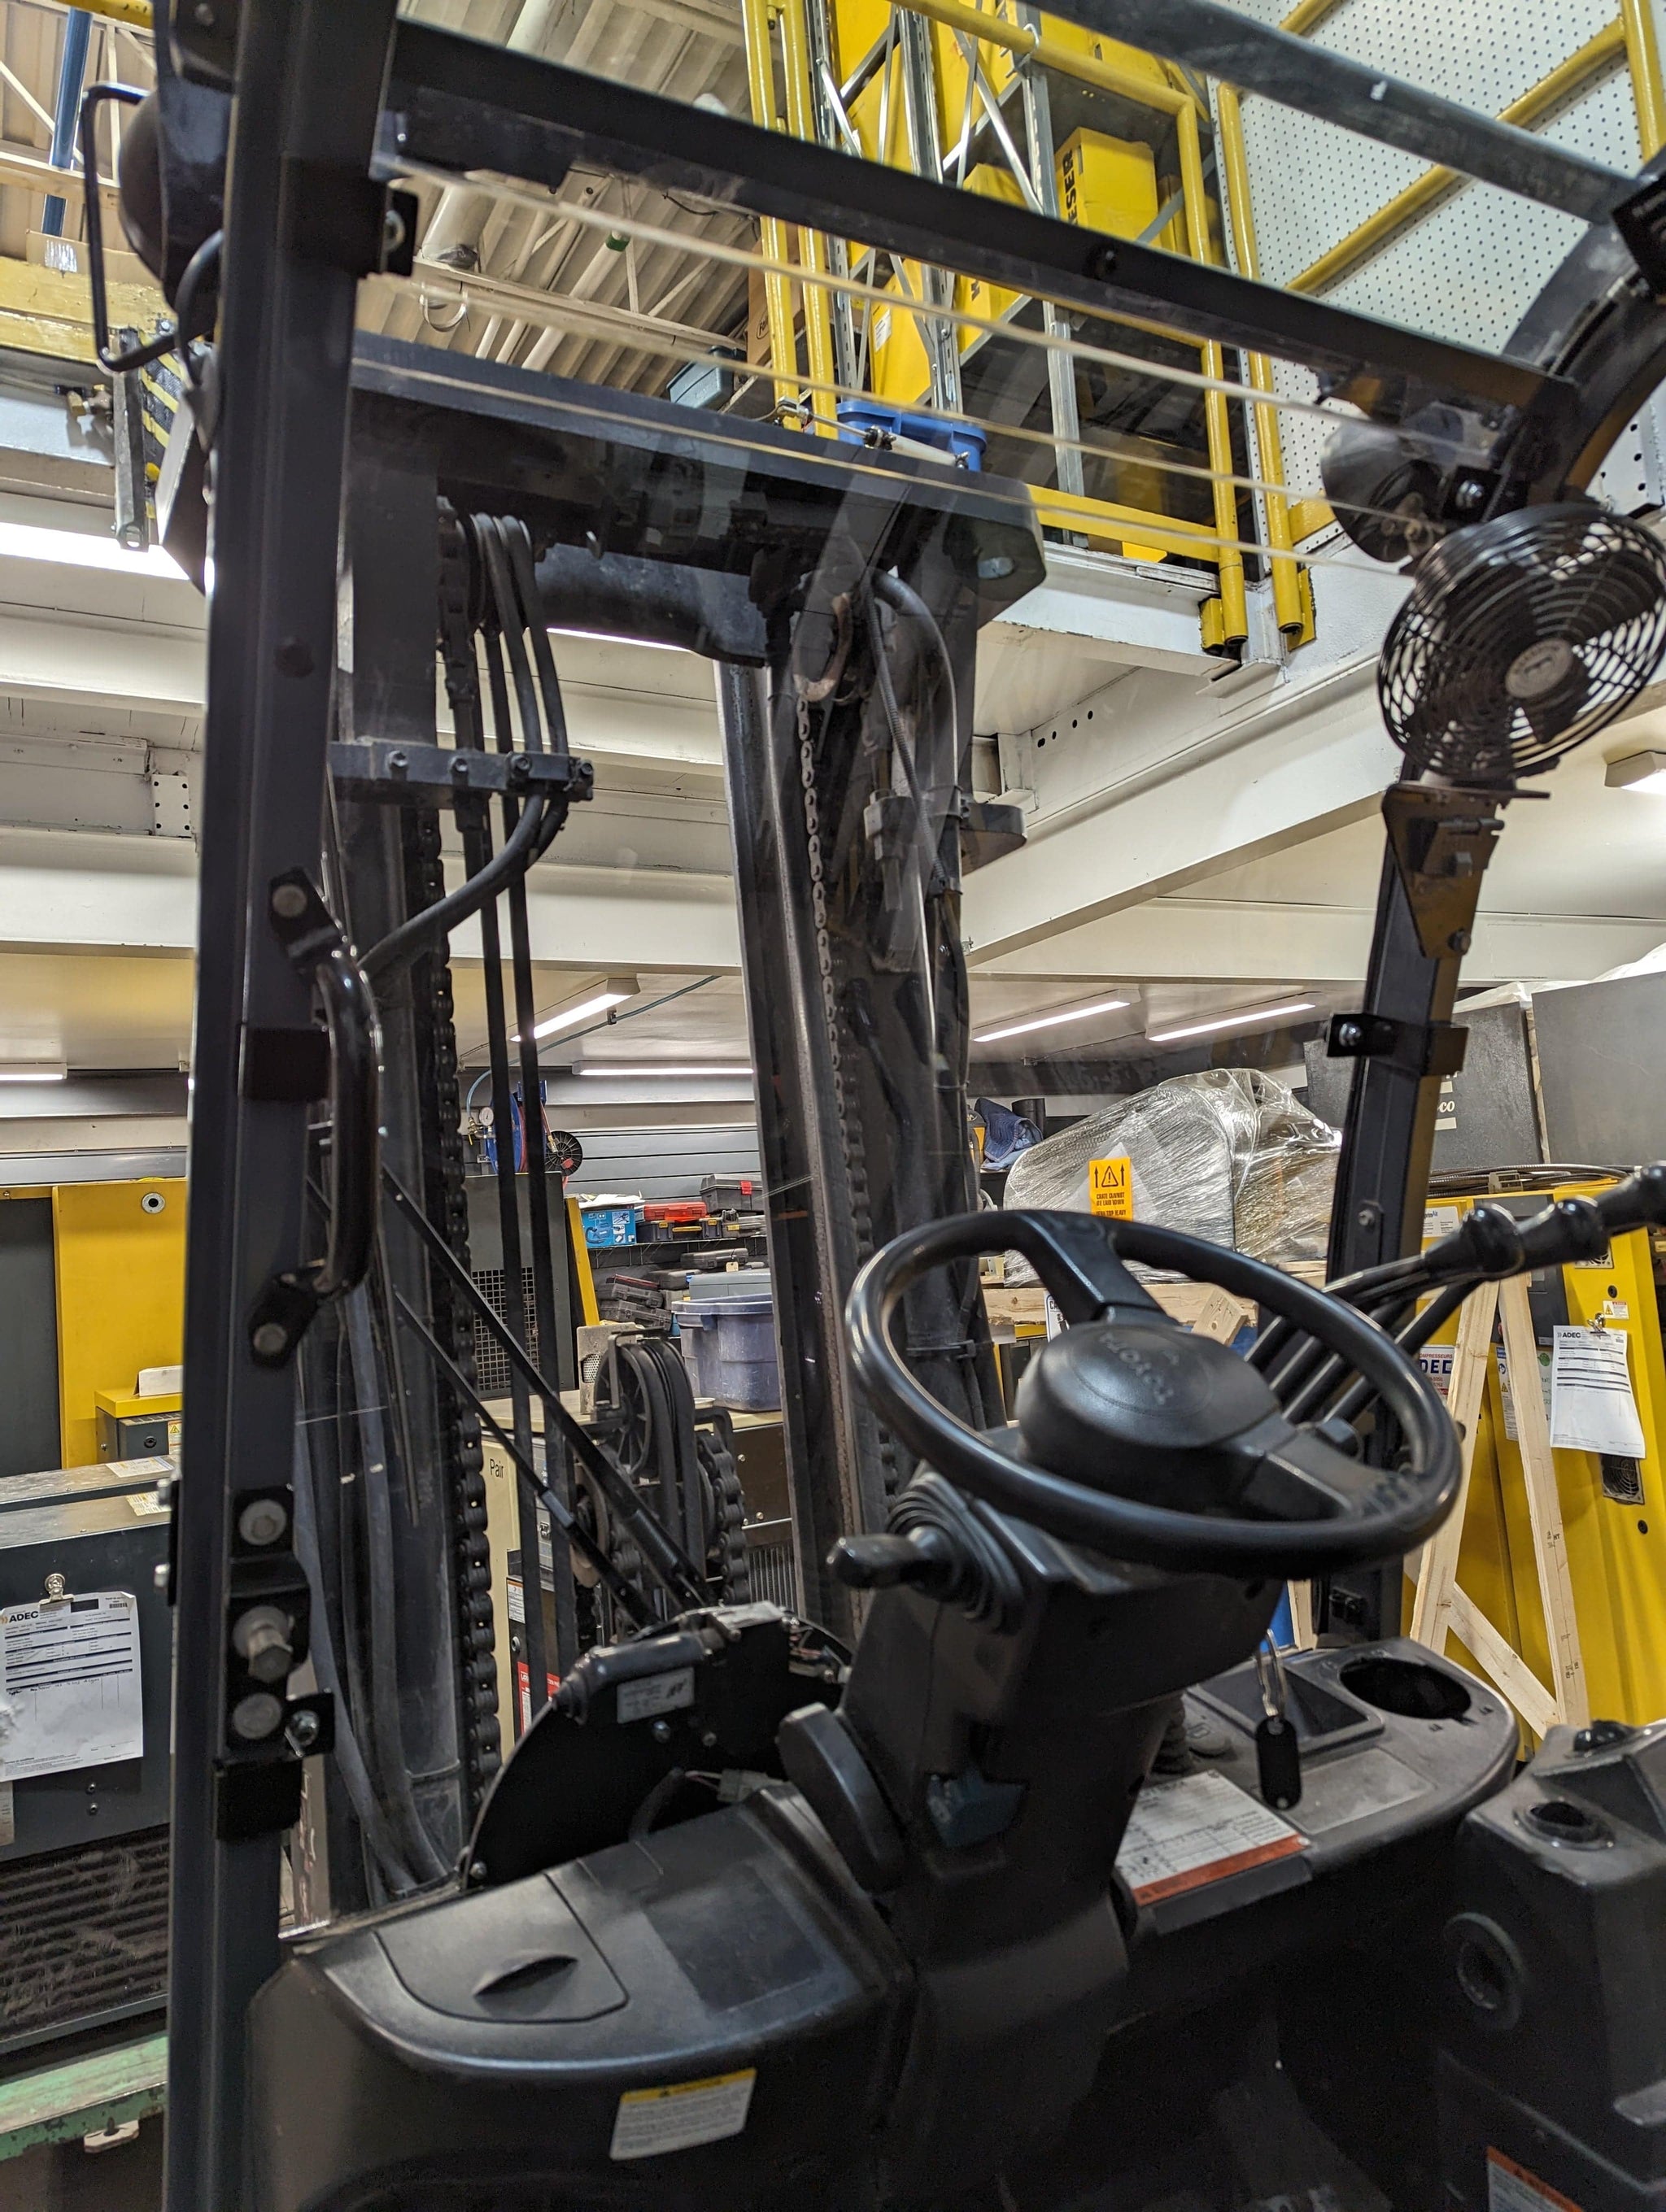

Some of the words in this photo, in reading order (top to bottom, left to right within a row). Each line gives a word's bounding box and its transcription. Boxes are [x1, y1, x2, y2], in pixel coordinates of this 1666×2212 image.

[1420, 1360, 1452, 1374] DEC
[490, 1458, 504, 1478] Pair
[9, 1611, 38, 1622] ADEC
